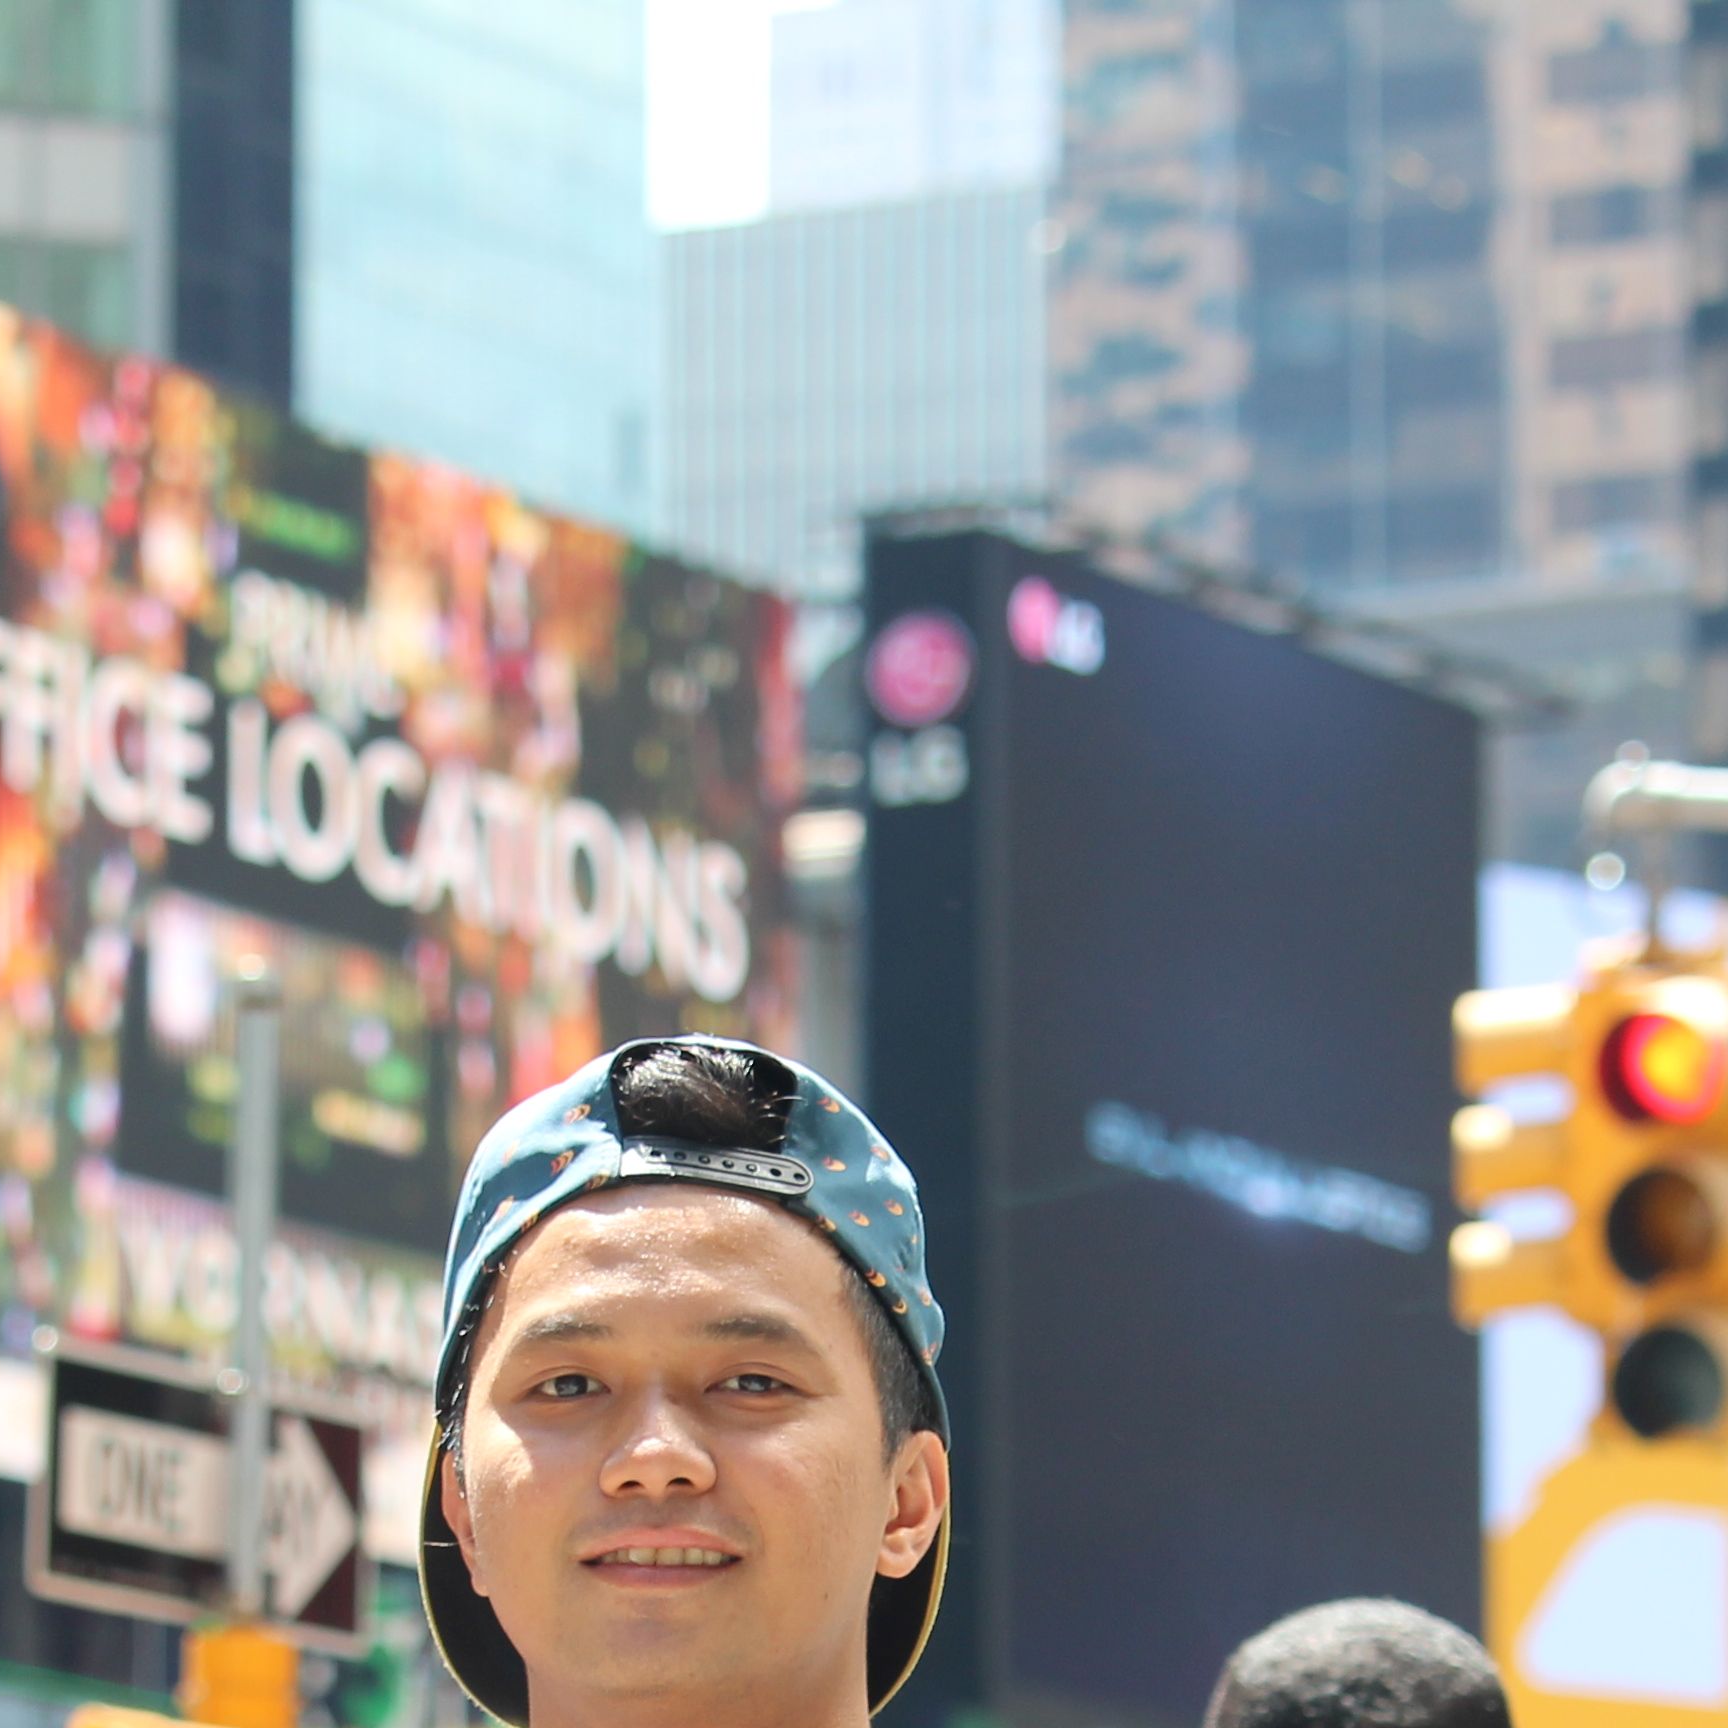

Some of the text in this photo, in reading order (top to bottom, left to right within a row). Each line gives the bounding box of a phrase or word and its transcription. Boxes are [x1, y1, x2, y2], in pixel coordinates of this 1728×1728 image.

[870, 724, 970, 808] LG
[226, 697, 750, 1004] LOCATIONS
[84, 1437, 185, 1535] ONE
